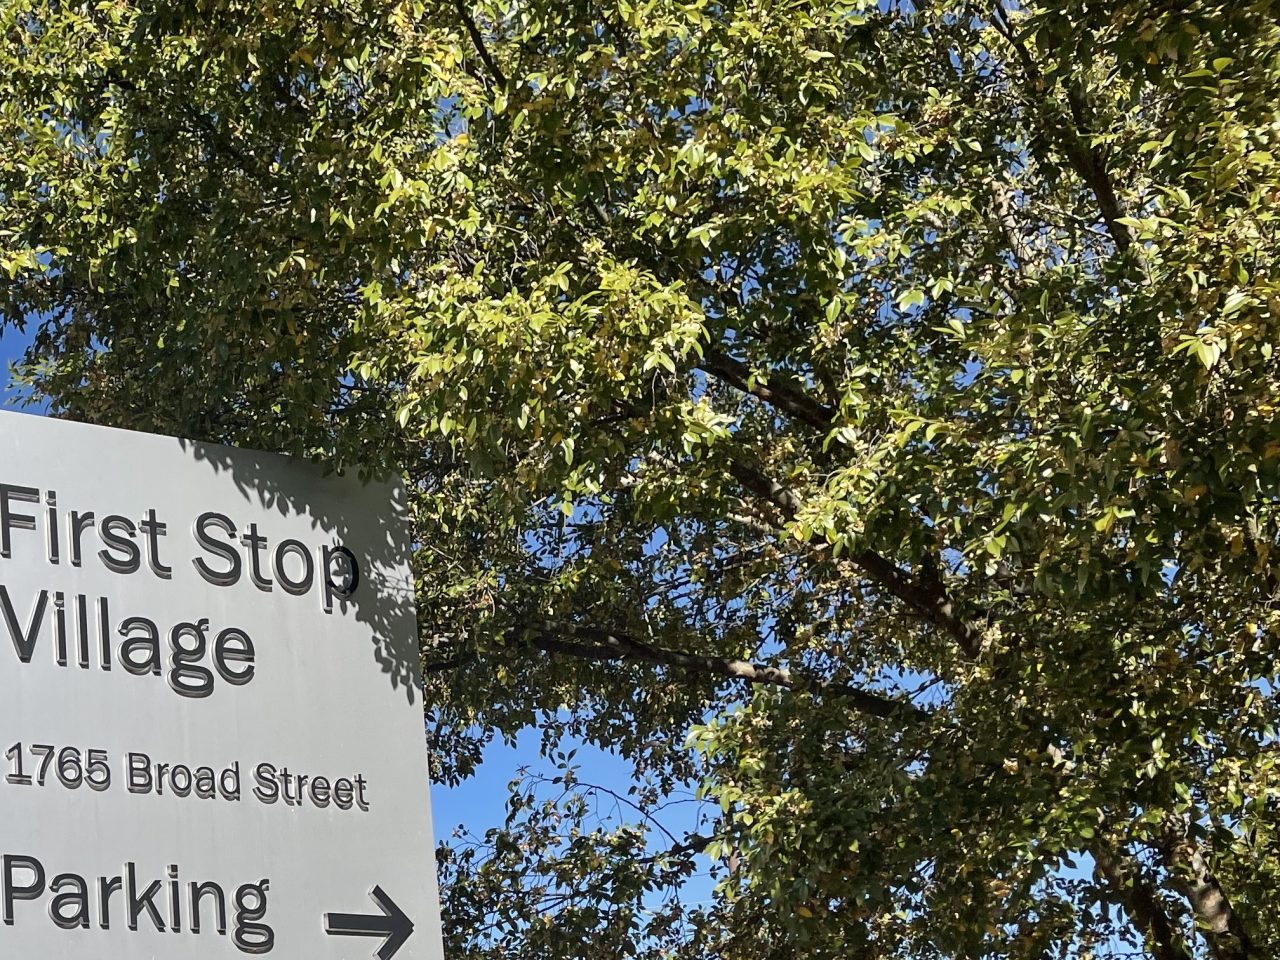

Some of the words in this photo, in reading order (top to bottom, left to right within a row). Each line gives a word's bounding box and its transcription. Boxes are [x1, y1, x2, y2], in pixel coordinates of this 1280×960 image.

[192, 511, 360, 614] Stop
[5, 742, 111, 791] 1765
[125, 752, 241, 800] Broad
[252, 762, 370, 812] Street
[0, 854, 275, 955] Parking
